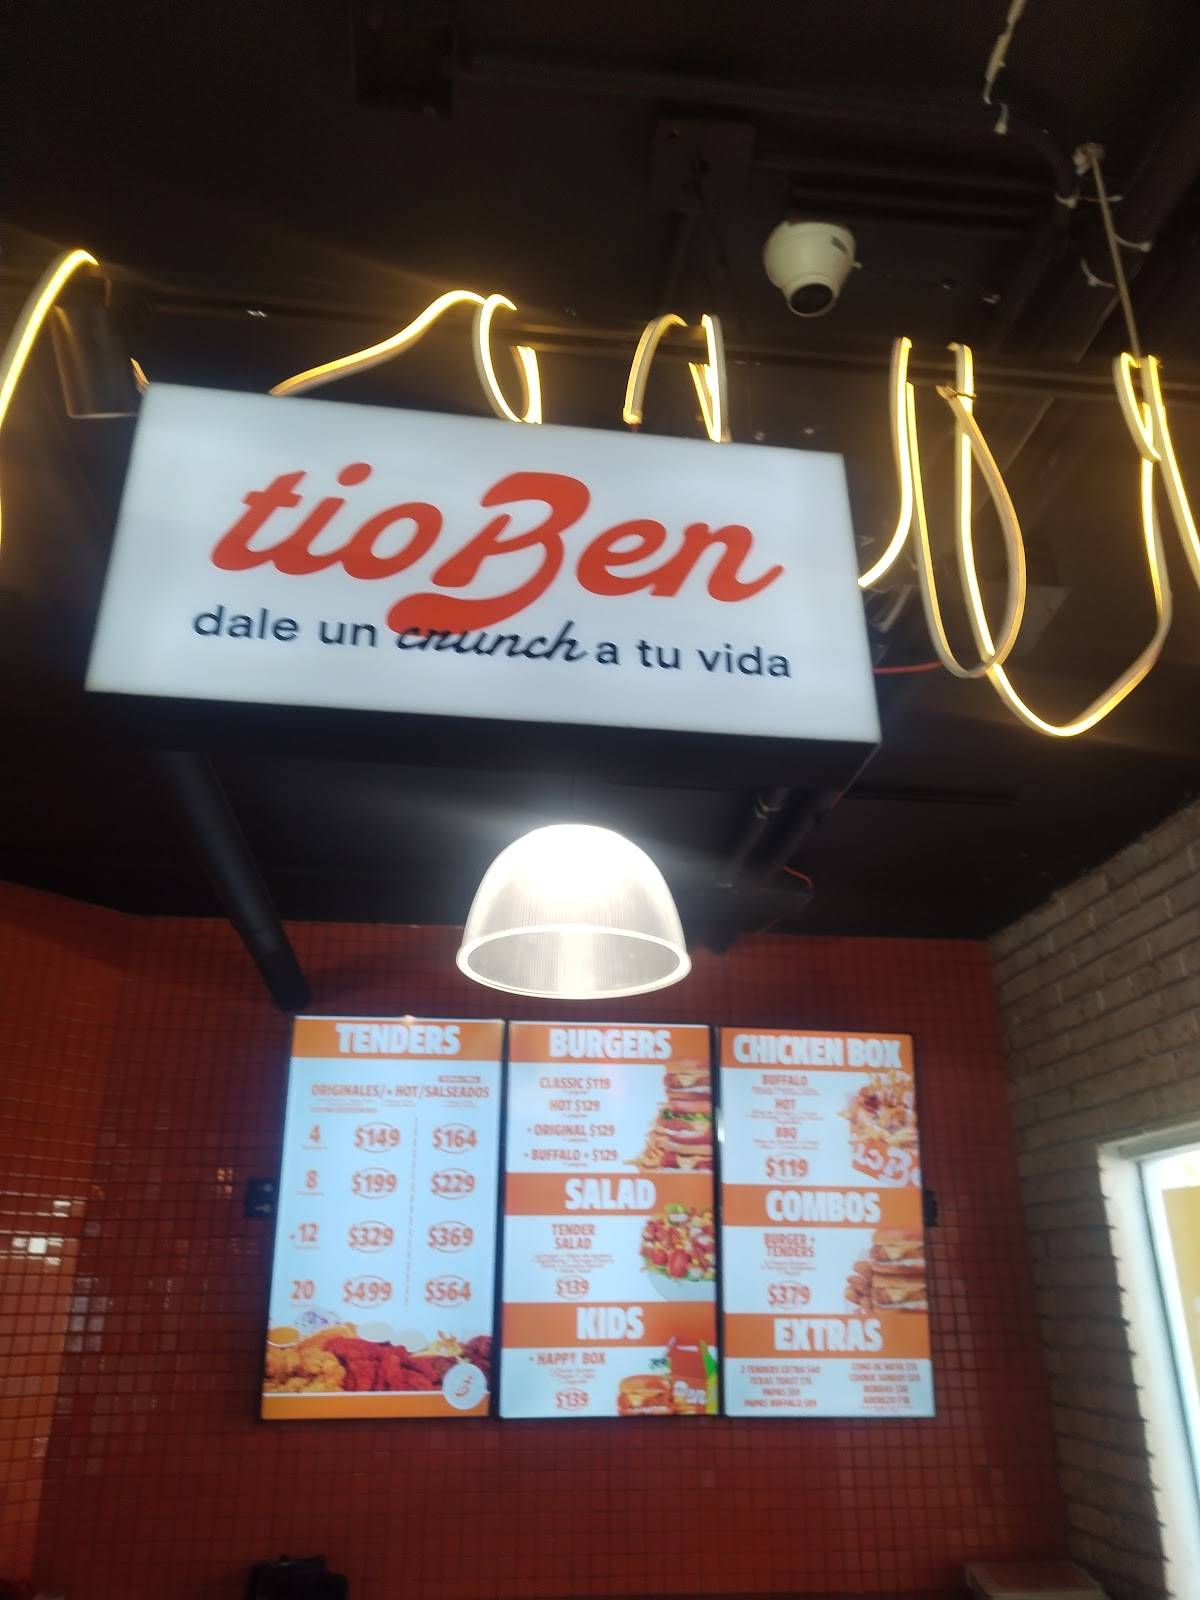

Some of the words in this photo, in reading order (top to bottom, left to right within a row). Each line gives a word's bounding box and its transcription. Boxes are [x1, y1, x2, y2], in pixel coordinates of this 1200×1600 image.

[192, 605, 299, 641] dale
[318, 621, 378, 648] un
[396, 620, 588, 662] crunch
[597, 640, 619, 665] a
[638, 639, 681, 670] tu
[698, 643, 791, 678] vida
[336, 1023, 461, 1055] TENDERS
[549, 1028, 672, 1059] BURGERS
[733, 1033, 845, 1067] CHICKEN
[846, 1037, 903, 1069] BOX
[539, 1077, 583, 1089] CLASSIC
[762, 1074, 808, 1087] BUFFALO
[550, 1100, 571, 1112] HOT
[575, 1100, 601, 1112] $129
[775, 1099, 796, 1111] HOT
[309, 1125, 320, 1143] 4
[354, 1127, 400, 1149] $149
[432, 1128, 477, 1150] $164
[535, 1124, 586, 1136] ORIGINAL
[590, 1124, 615, 1137] $129
[775, 1126, 798, 1139] BBQ
[531, 1149, 581, 1161] BUFFALO
[592, 1149, 618, 1162] $129
[765, 1156, 809, 1179] $119
[306, 1169, 318, 1188] 8
[351, 1173, 397, 1195] $199
[431, 1173, 475, 1195] $229
[564, 1178, 657, 1210] SALAD
[765, 1190, 881, 1223] COMBOS
[300, 1223, 319, 1242] 12
[348, 1226, 393, 1248] $329
[428, 1226, 474, 1248] $369
[552, 1224, 596, 1236] TENDER
[764, 1232, 807, 1247] BURGER
[555, 1238, 592, 1250] SALAD
[767, 1245, 815, 1258] TENDERS
[292, 1280, 315, 1300] 20
[343, 1281, 392, 1303] $499
[426, 1281, 471, 1303] $564
[556, 1279, 590, 1296] $139
[768, 1284, 811, 1306] $379
[576, 1306, 645, 1341] KIDS
[774, 1319, 883, 1352] EXTRAS
[537, 1352, 577, 1365] HAPPY
[582, 1352, 607, 1365] BOX
